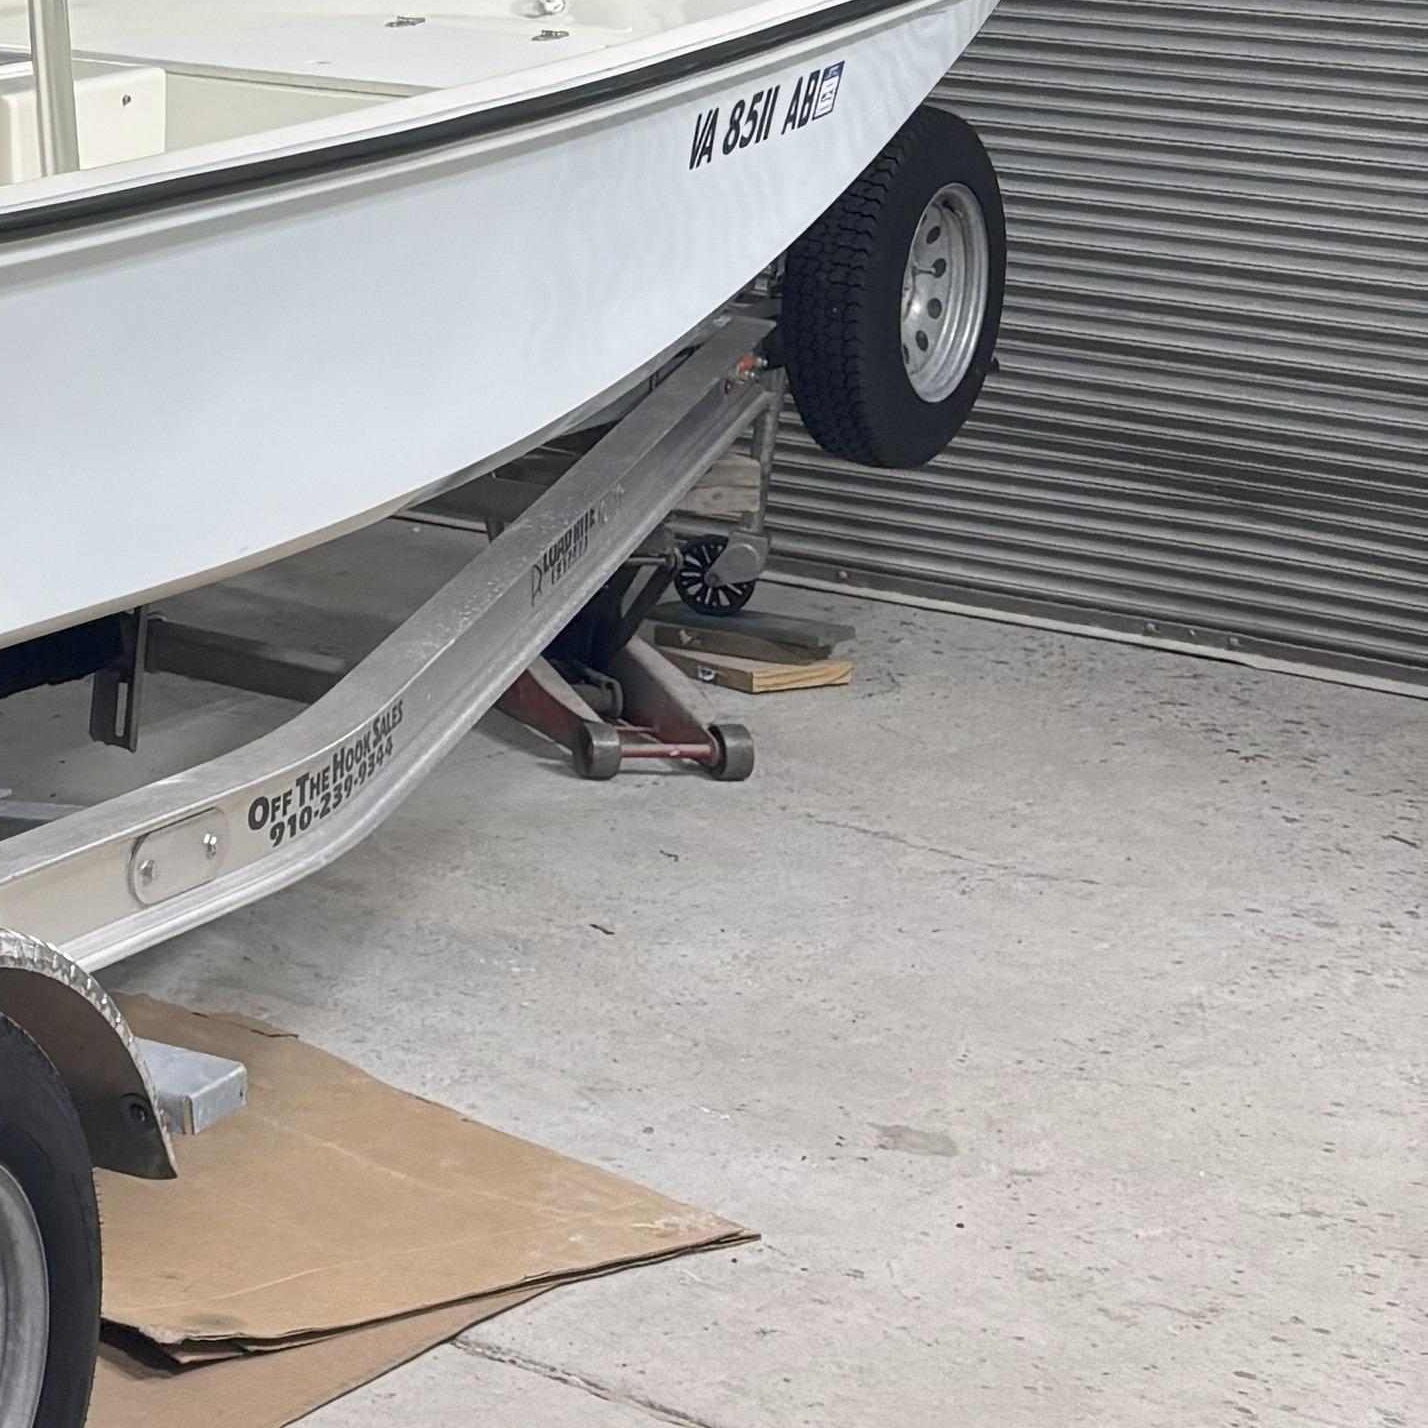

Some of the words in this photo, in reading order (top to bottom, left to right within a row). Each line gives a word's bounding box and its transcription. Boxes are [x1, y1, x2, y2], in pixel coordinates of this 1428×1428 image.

[688, 107, 720, 170] VA
[721, 84, 781, 156] 8511
[781, 69, 821, 135] AB
[248, 788, 293, 831] OFF
[295, 766, 331, 808] THE
[332, 728, 373, 785] HOOK
[372, 699, 404, 748] SALES
[269, 735, 394, 848] 910-239-9344
